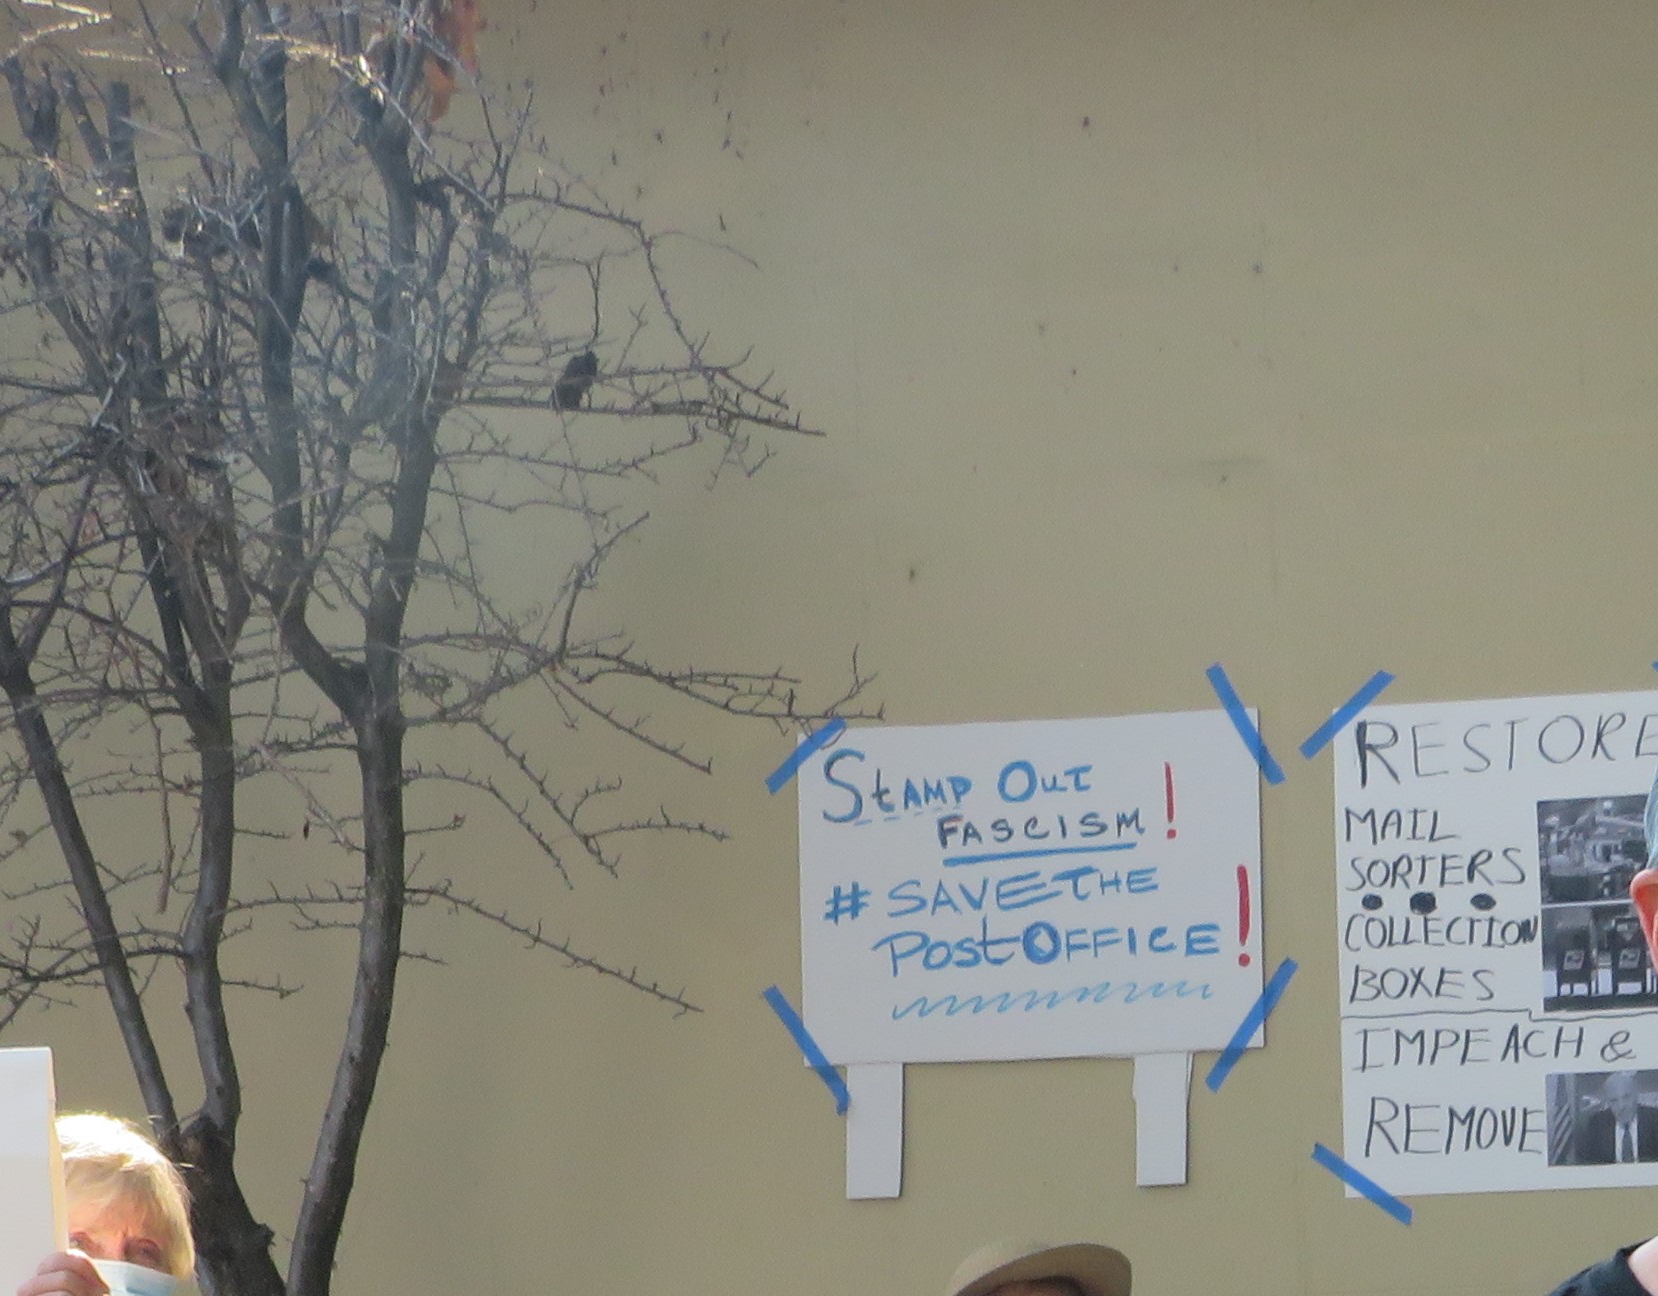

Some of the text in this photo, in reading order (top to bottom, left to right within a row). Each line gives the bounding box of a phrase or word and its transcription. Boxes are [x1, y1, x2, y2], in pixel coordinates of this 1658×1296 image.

[1344, 806, 1462, 845] MAIL
[1344, 847, 1527, 892] SORTERS
[1344, 911, 1540, 953] COLLECTION
[1348, 963, 1496, 1004] BOXES
[1351, 1022, 1638, 1074] IMPEACH &
[1363, 1095, 1548, 1159] REMOVE
